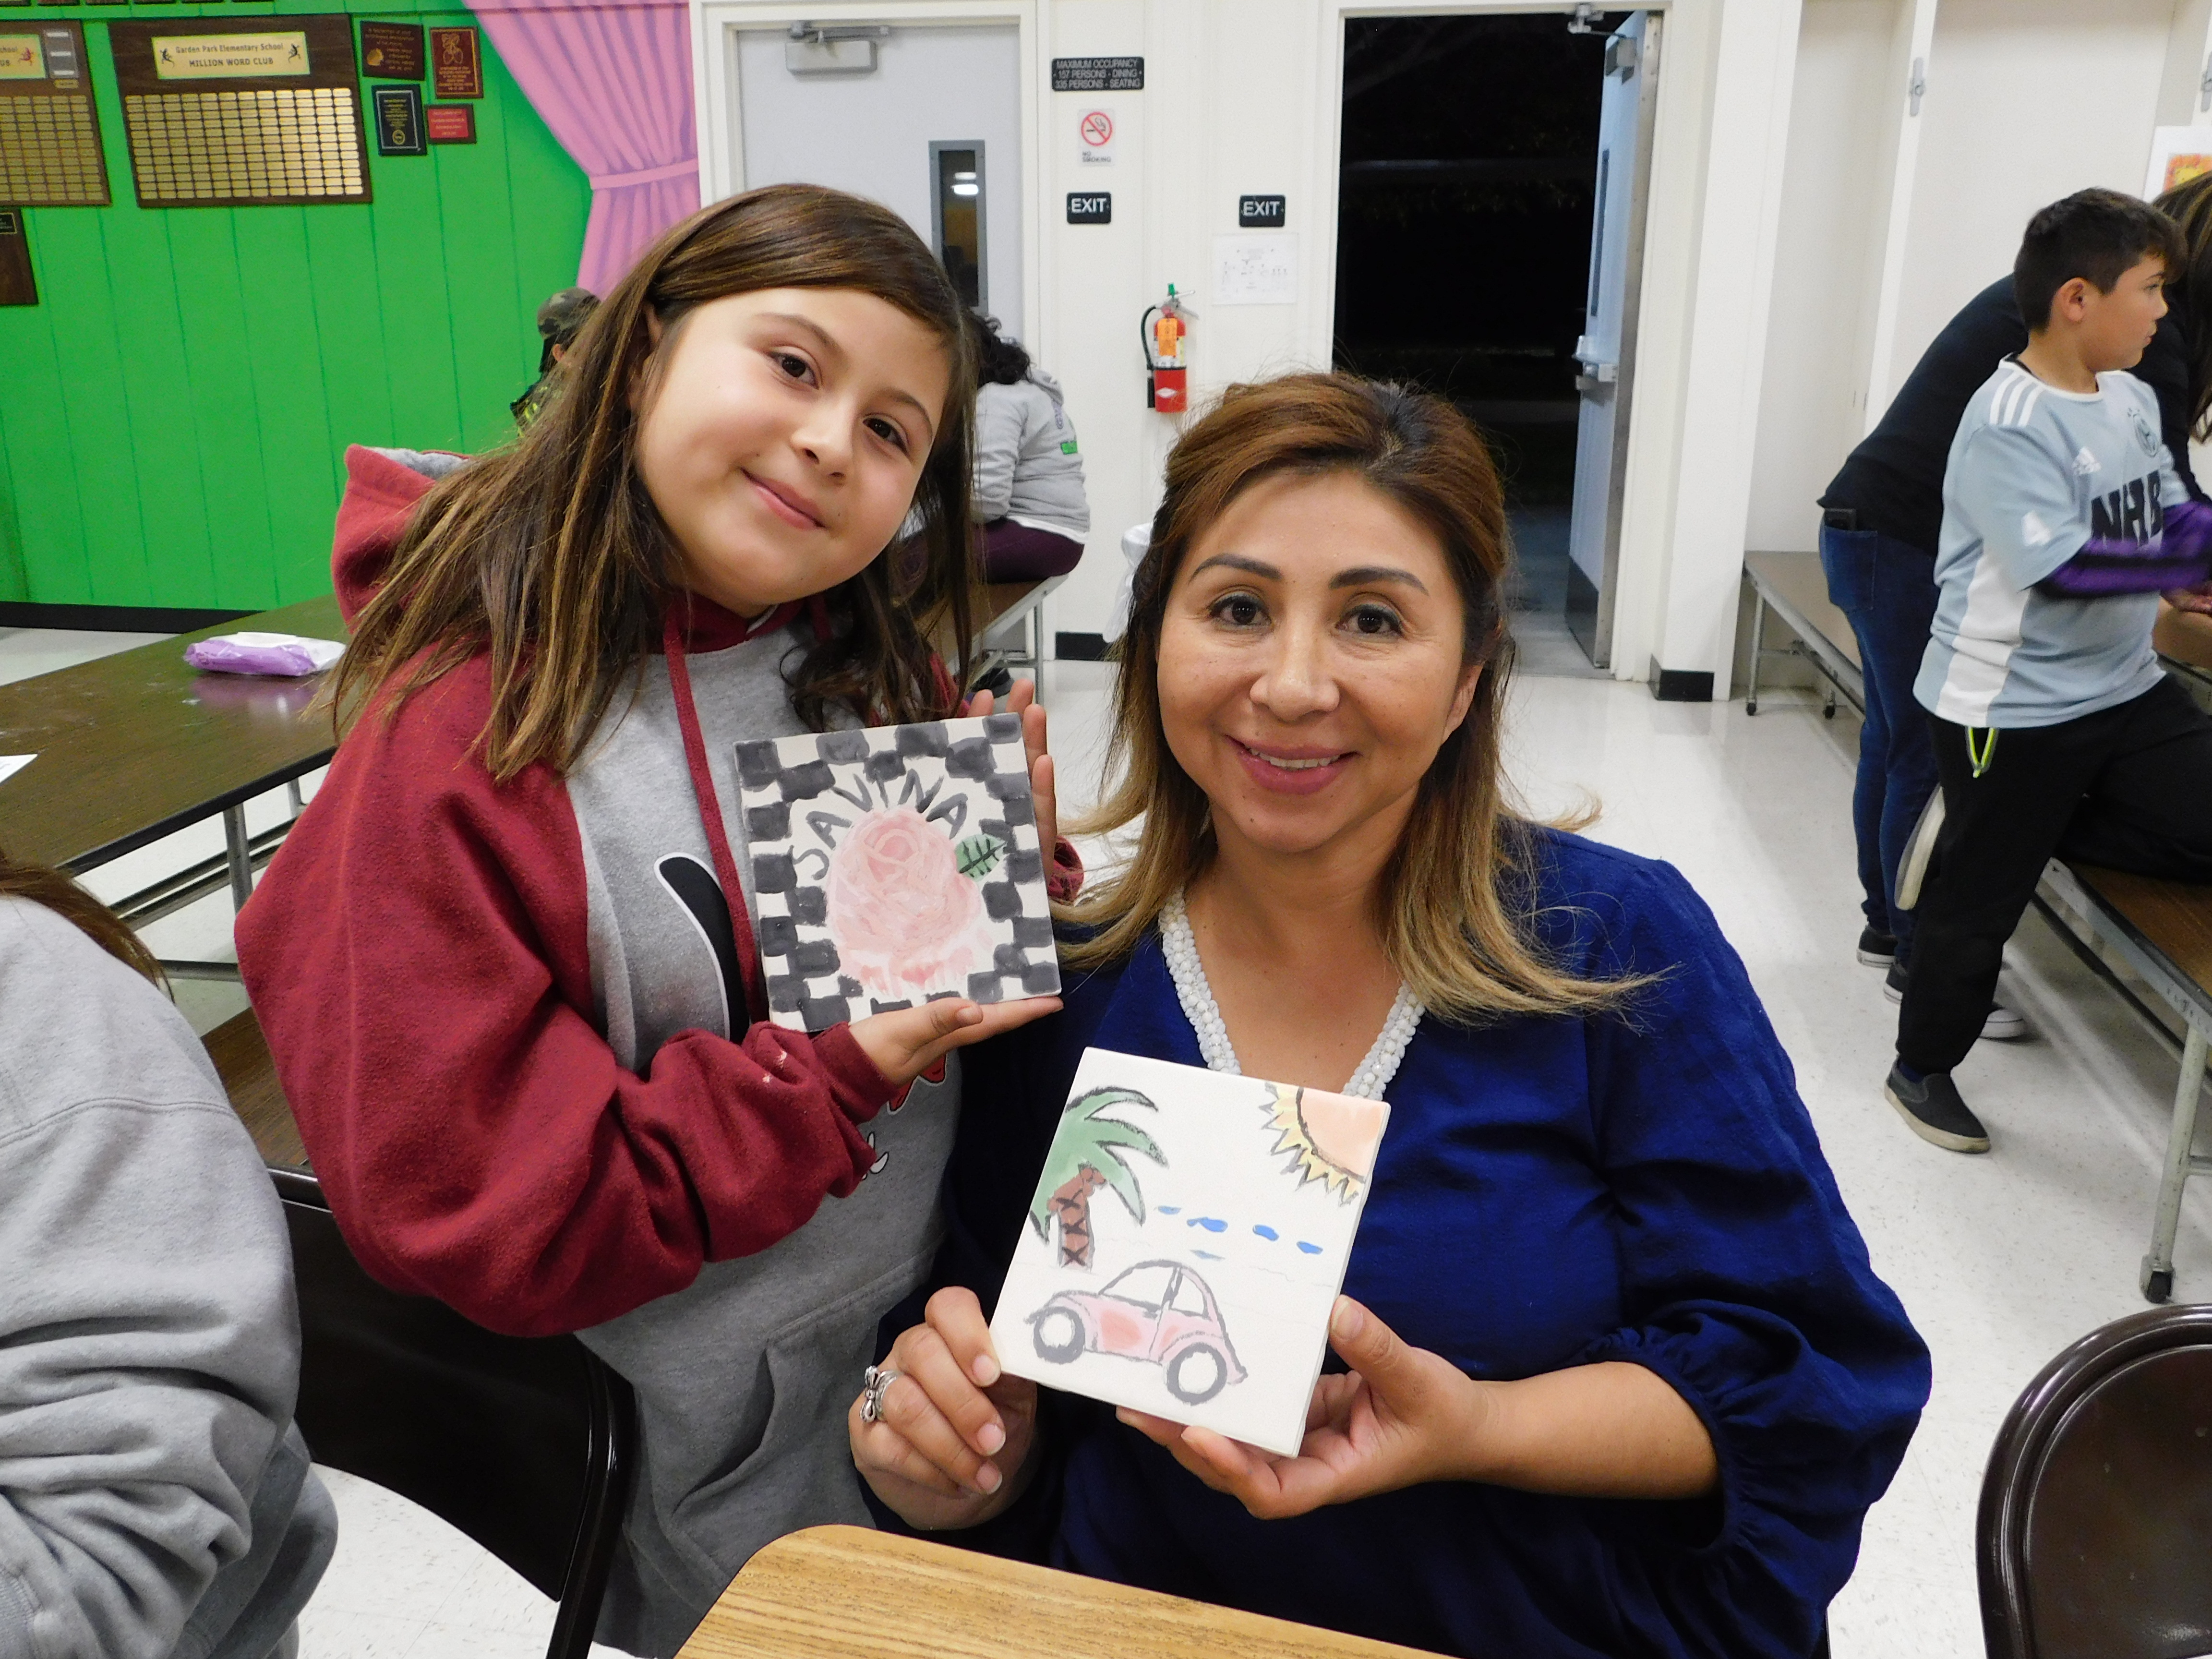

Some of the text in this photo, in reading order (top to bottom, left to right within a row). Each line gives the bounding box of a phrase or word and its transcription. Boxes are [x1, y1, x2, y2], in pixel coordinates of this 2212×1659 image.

[175, 46, 200, 54] Garden
[219, 43, 258, 53] Elementary
[260, 42, 284, 51] School
[189, 57, 274, 67] MILLION WORD CLUB
[1056, 59, 1137, 69] MAXIMUM OCCUPANCY
[1071, 69, 1106, 79] PERSONS
[1112, 69, 1137, 78] DINING
[1069, 79, 1104, 89] PERSONS
[1109, 78, 1141, 88] SEATING
[1071, 197, 1107, 213] EXIT
[1243, 200, 1280, 217] EXIT
[793, 768, 969, 881] SAVINA
